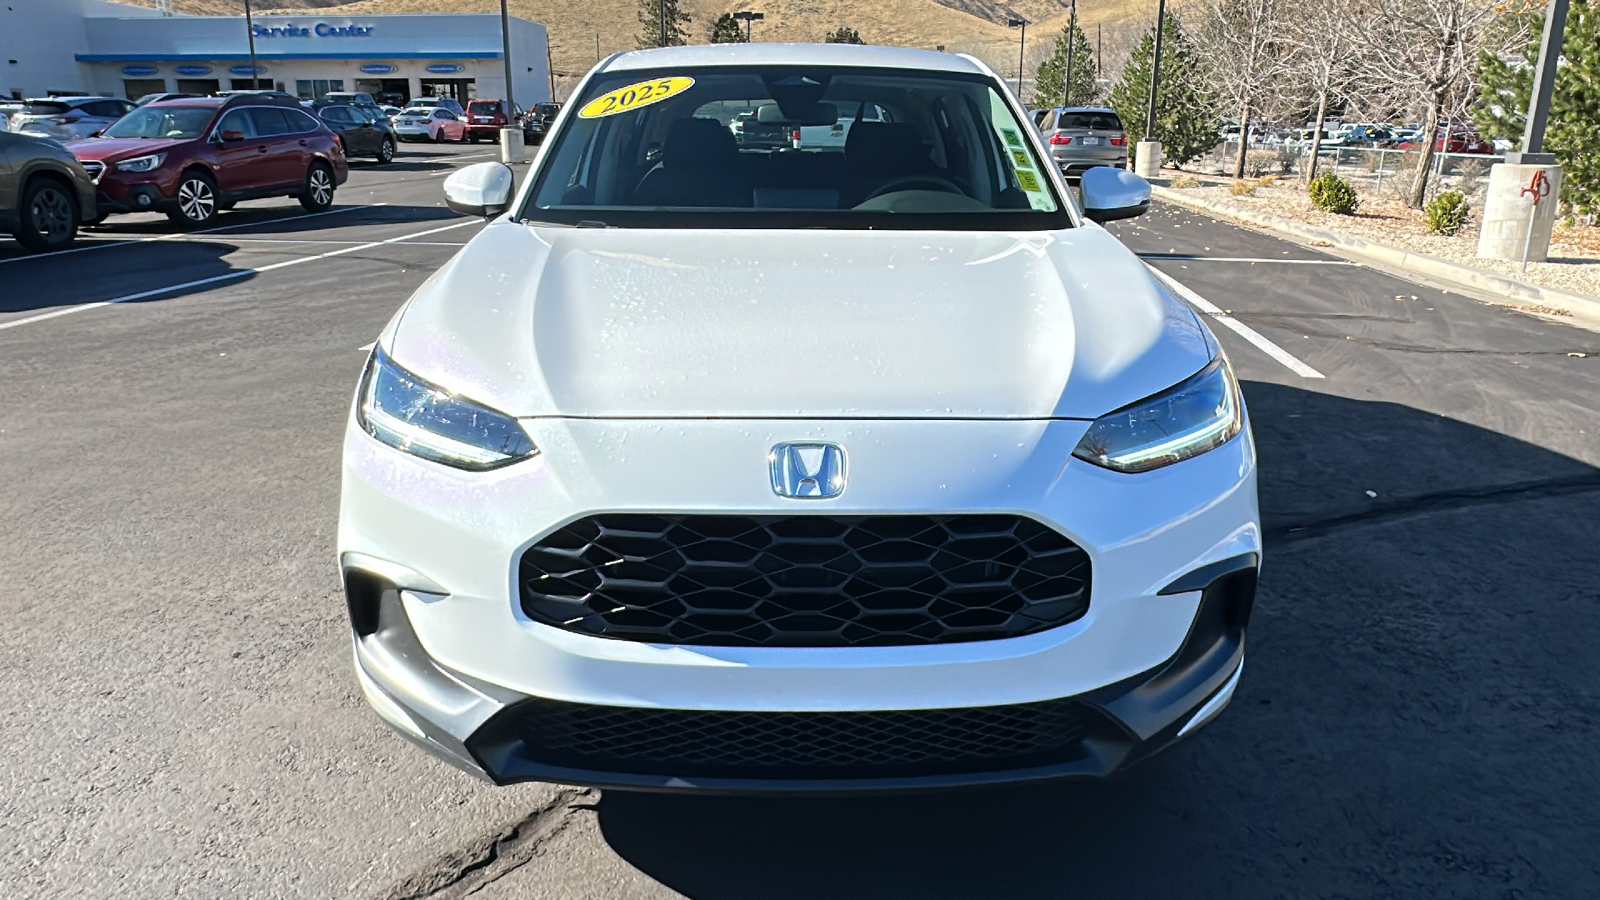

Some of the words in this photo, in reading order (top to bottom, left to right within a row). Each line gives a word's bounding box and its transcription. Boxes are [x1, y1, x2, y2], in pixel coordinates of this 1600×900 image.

[252, 23, 310, 37] Service
[314, 23, 374, 37] Center
[600, 78, 672, 114] 2025
